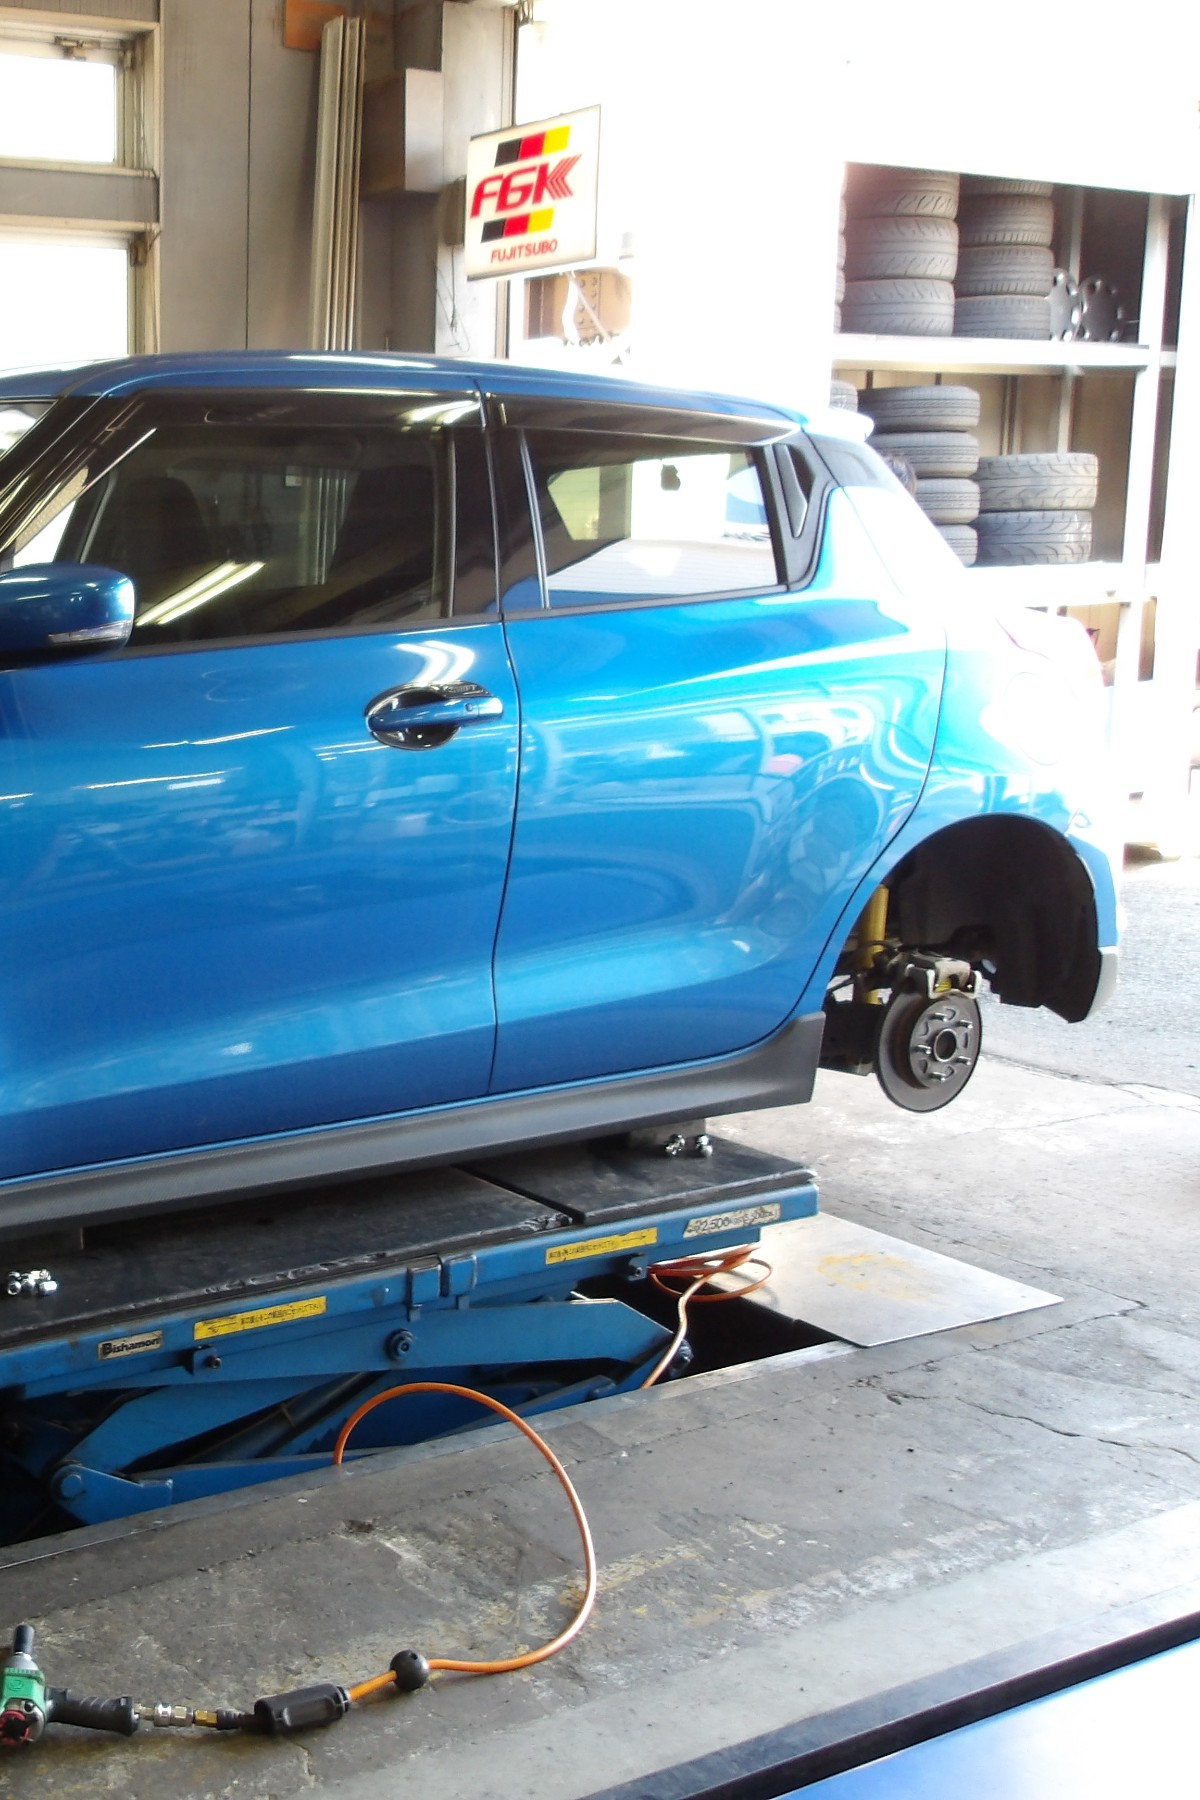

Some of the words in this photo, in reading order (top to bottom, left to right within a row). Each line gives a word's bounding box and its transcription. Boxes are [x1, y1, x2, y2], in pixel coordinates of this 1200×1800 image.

[470, 153, 583, 219] FGK
[490, 239, 558, 264] FUJITSUBO
[102, 1338, 160, 1355] Bishamon
